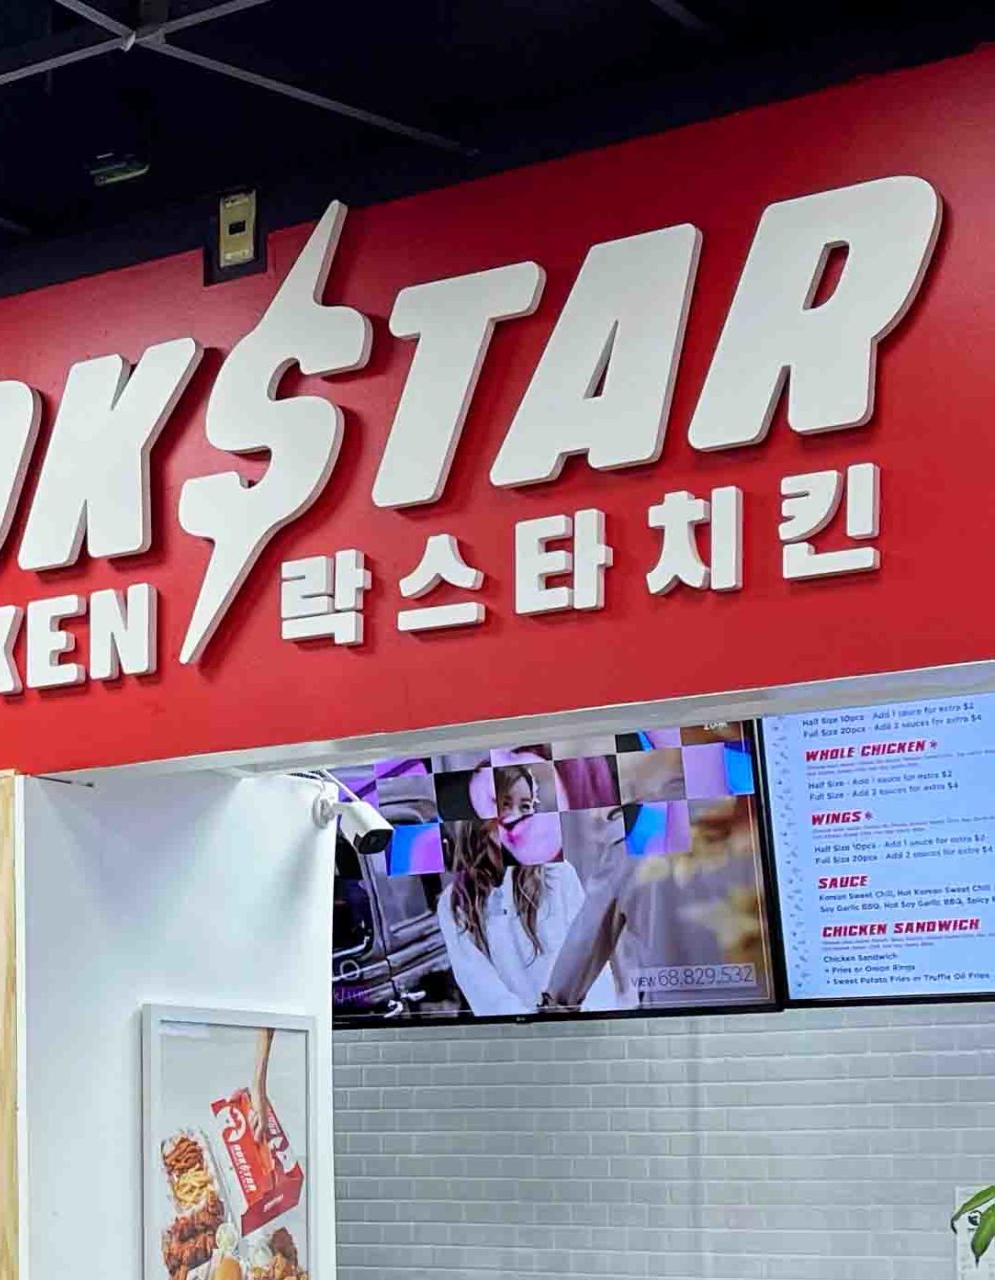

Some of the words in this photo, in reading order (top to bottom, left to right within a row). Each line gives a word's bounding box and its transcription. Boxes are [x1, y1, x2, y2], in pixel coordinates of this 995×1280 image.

[806, 747, 855, 762] WHOLE
[861, 740, 926, 757] CHICKEN
[812, 811, 862, 825] WINGS
[818, 875, 868, 889] SAUCE
[822, 923, 887, 938] CHICKEN
[893, 919, 980, 934] SANDWICH
[823, 955, 855, 963] Chicken
[857, 953, 897, 961] Sandwich
